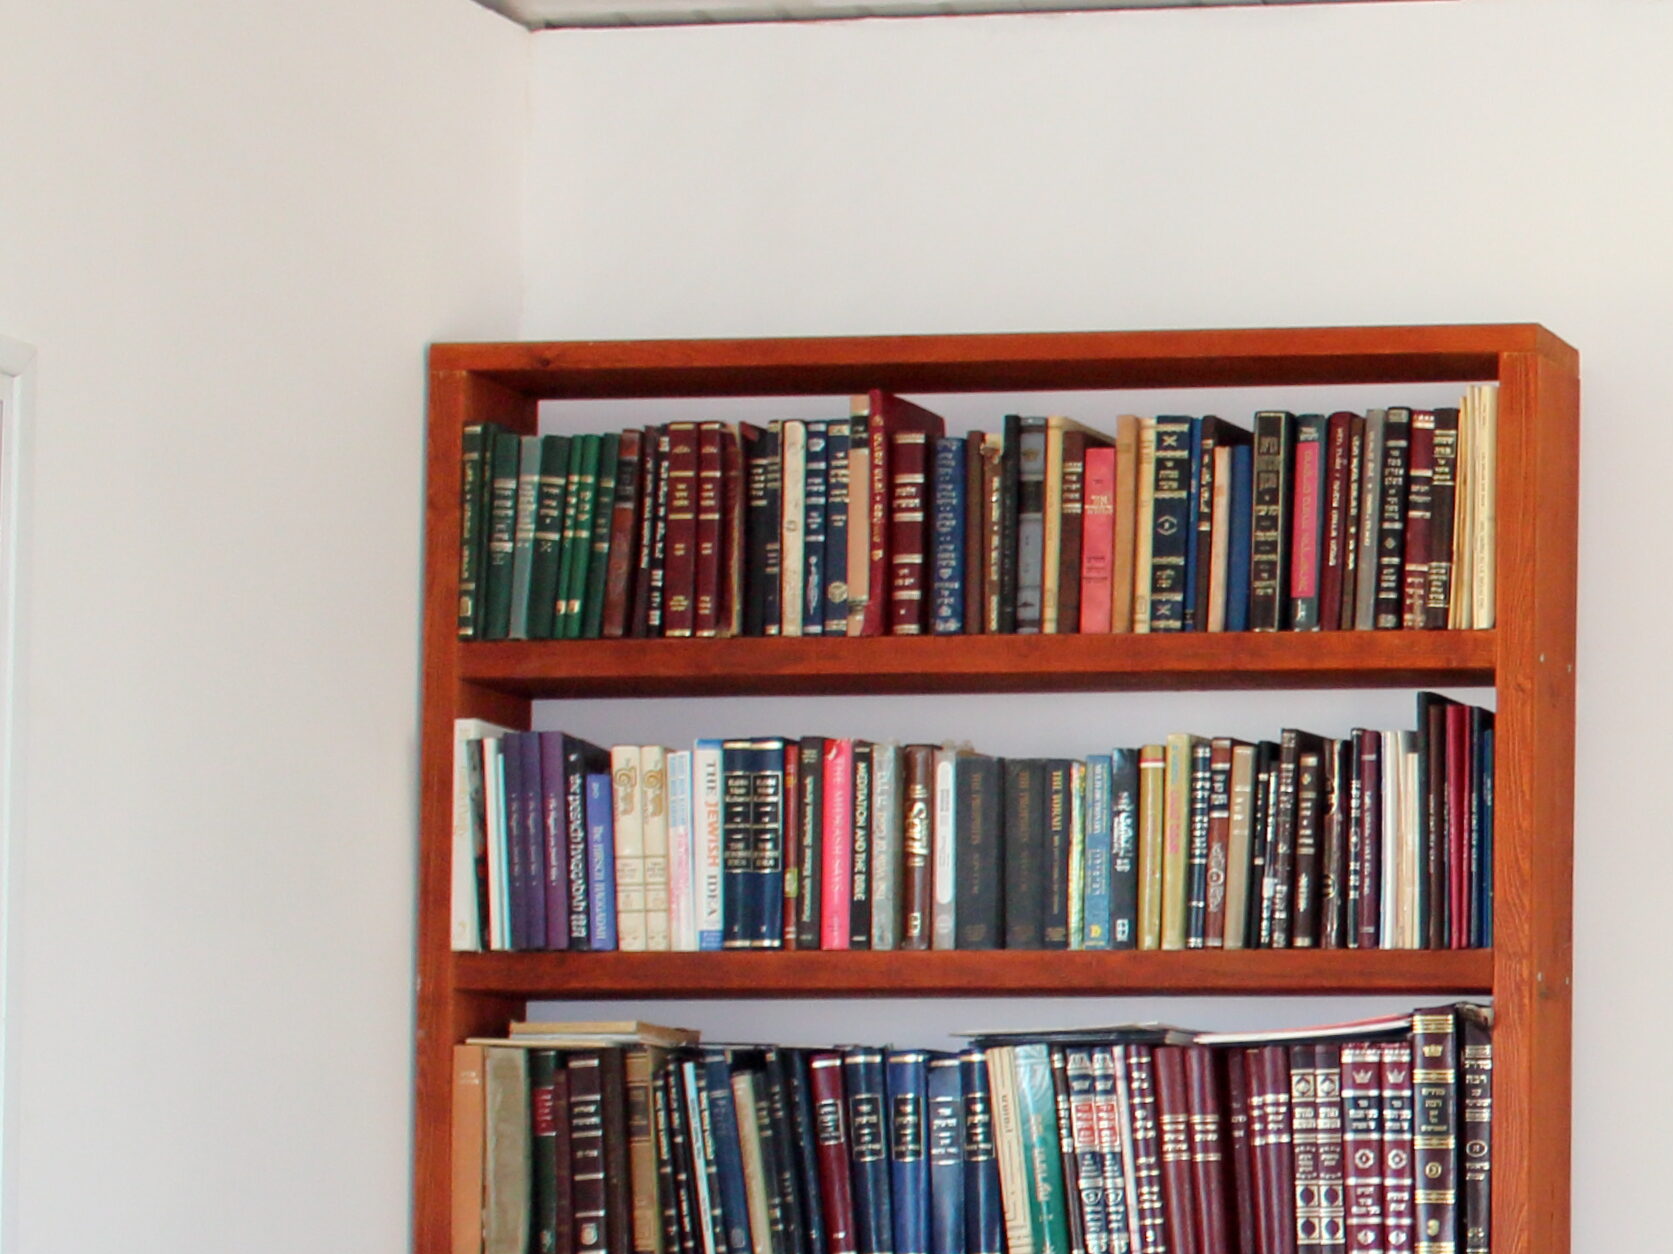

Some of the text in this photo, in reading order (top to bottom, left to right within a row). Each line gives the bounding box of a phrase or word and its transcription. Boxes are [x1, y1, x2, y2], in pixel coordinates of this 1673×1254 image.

[705, 760, 720, 917] THE JEWISH IDEA
[853, 761, 868, 901] MEDITATION AND THE BIBLE
